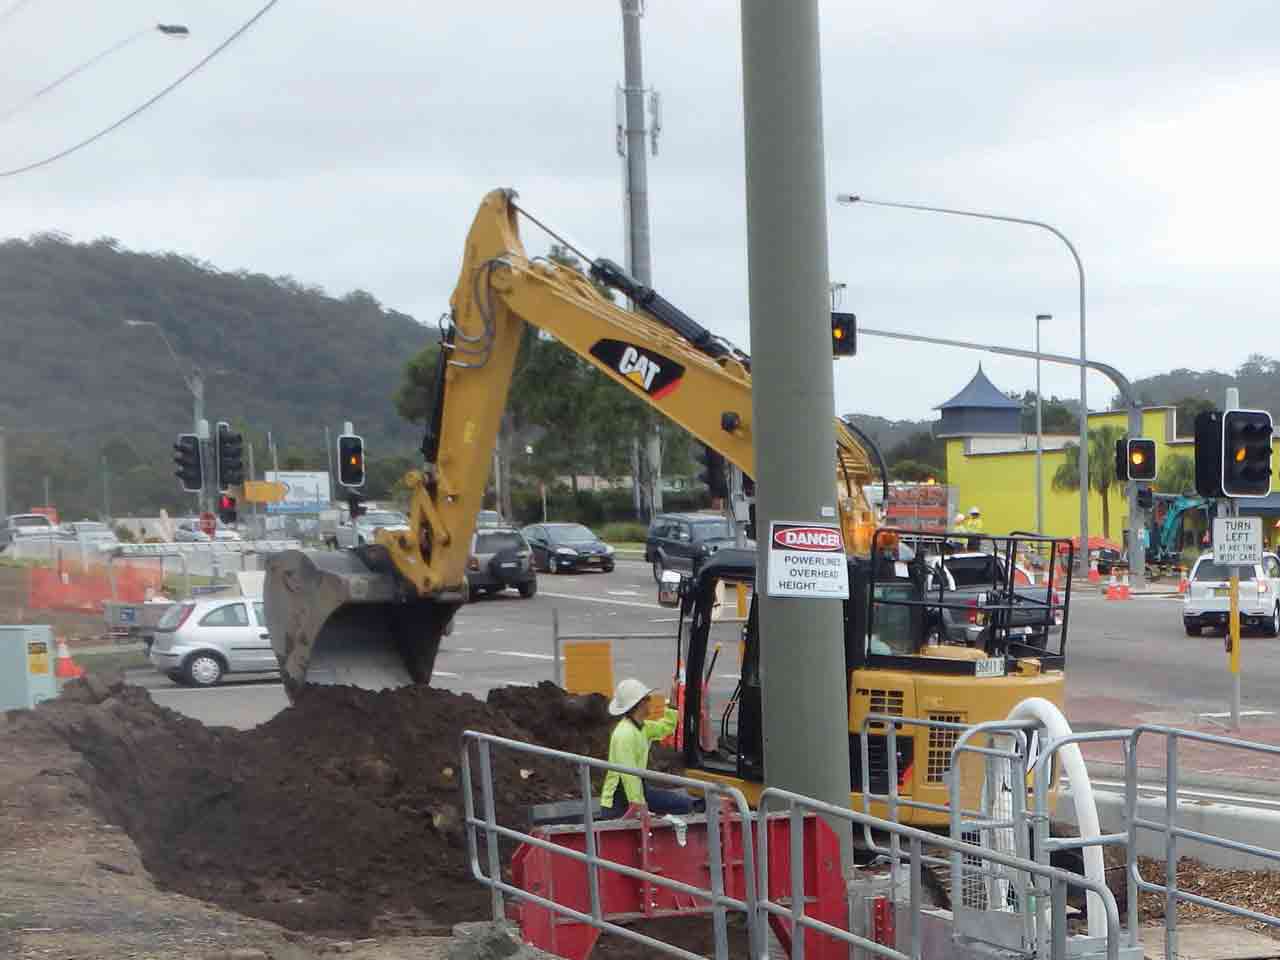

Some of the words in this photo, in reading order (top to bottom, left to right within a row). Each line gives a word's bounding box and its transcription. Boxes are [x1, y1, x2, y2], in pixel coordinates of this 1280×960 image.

[619, 346, 661, 391] CAT
[1224, 520, 1252, 530] TURN
[784, 531, 841, 546] DANGER
[1225, 532, 1249, 542] LEFT
[778, 580, 817, 591] HEIGHT
